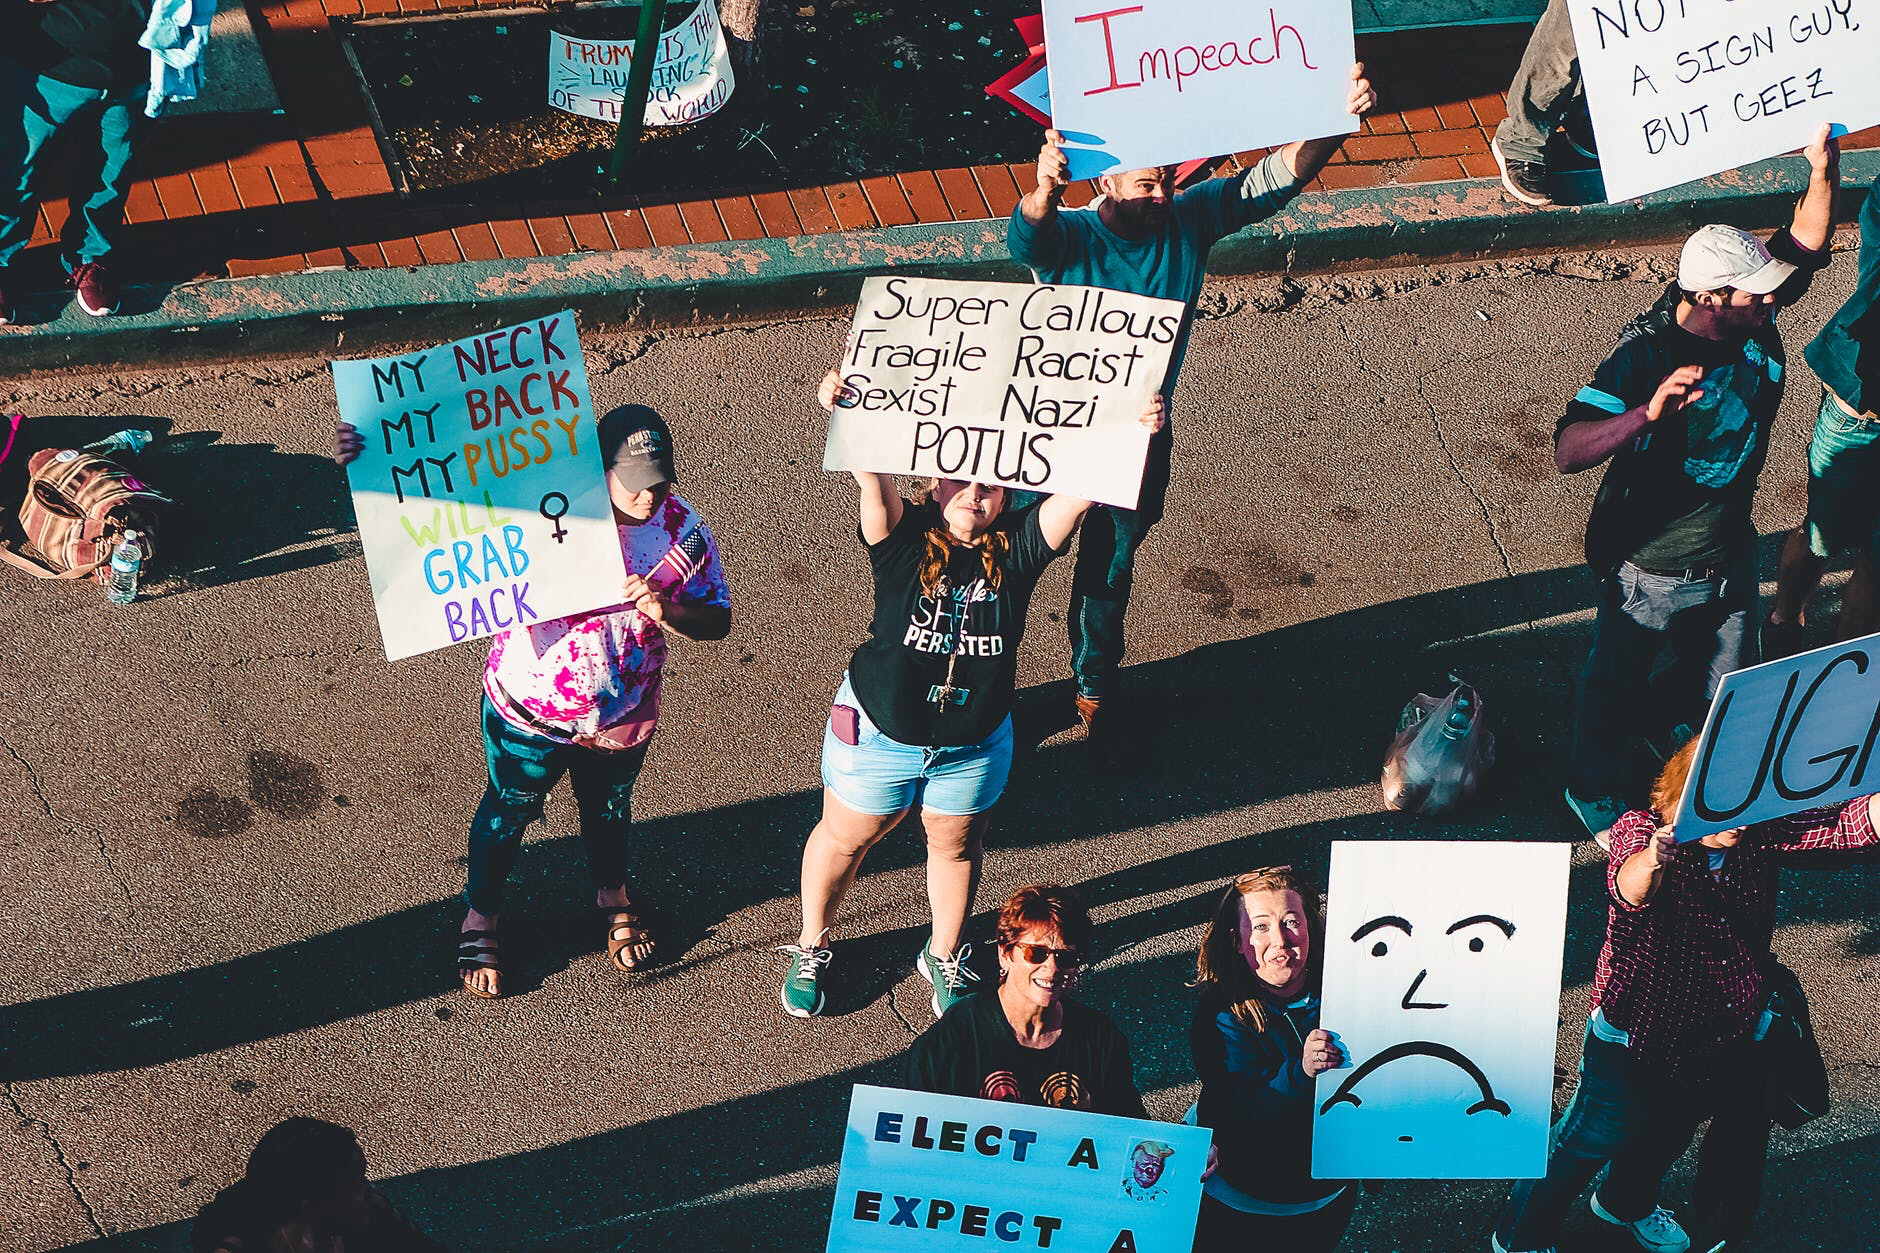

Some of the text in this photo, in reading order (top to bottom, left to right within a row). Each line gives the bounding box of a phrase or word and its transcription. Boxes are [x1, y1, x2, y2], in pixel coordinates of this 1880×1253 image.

[559, 36, 633, 65] TRUM
[661, 31, 684, 63] IS
[590, 56, 694, 88] LAUING
[1074, 5, 1318, 95] Impeach
[1632, 65, 1658, 96] A
[1675, 27, 1774, 83] SIGN
[551, 89, 580, 110] OF
[660, 78, 727, 121] WORLD
[608, 85, 681, 103] SCK
[1642, 68, 1833, 155] BUT GEEZ
[874, 279, 1178, 343] Super Callous
[371, 318, 566, 402] MY NECK
[850, 329, 1144, 387] Fragile Racist
[381, 369, 580, 454] MY BACK
[833, 374, 1099, 427] Sexist Nazi
[391, 452, 457, 503] MY
[463, 414, 580, 487] PUSSY
[911, 421, 1054, 486] POTUS
[401, 490, 512, 547] WILL
[424, 525, 529, 595] GRAB
[445, 582, 538, 642] BACK
[903, 624, 1003, 656] PERSSTED
[874, 1111, 1099, 1170] ELECT A
[853, 1190, 1138, 1253] EXPECT A
